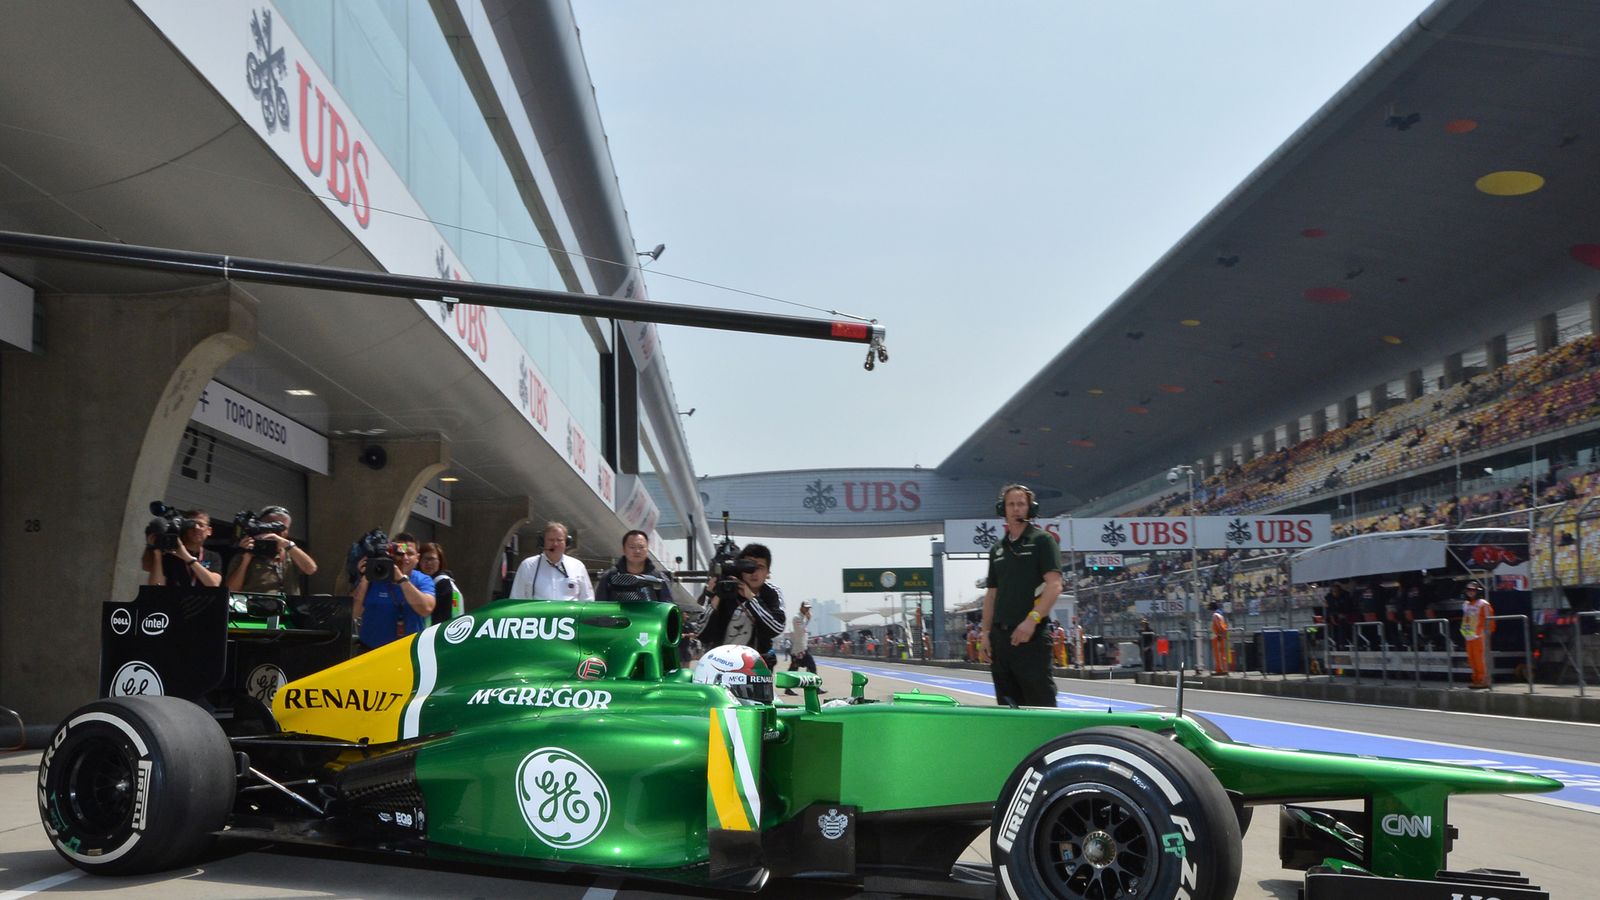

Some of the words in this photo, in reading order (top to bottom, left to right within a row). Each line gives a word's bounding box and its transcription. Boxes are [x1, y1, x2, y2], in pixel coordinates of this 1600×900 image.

[296, 60, 371, 229] UBS
[529, 368, 549, 432] UBS
[224, 397, 253, 430] TORO
[255, 413, 288, 444] ROSSO
[180, 425, 218, 484] 27
[842, 480, 922, 513] UBS
[24, 519, 41, 533] 28
[1130, 520, 1189, 546] UBS
[1255, 518, 1314, 544] UBS
[1098, 555, 1122, 567] UBS
[475, 617, 576, 640] AIRBUS
[712, 656, 735, 668] AIRBUS
[284, 688, 404, 712] RENAULT
[467, 687, 613, 710] McGREGOR
[38, 725, 67, 809] ZERO
[131, 760, 153, 831] PIRELLI
[996, 766, 1044, 854] PIRELLI
[1381, 813, 1432, 838] CNN
